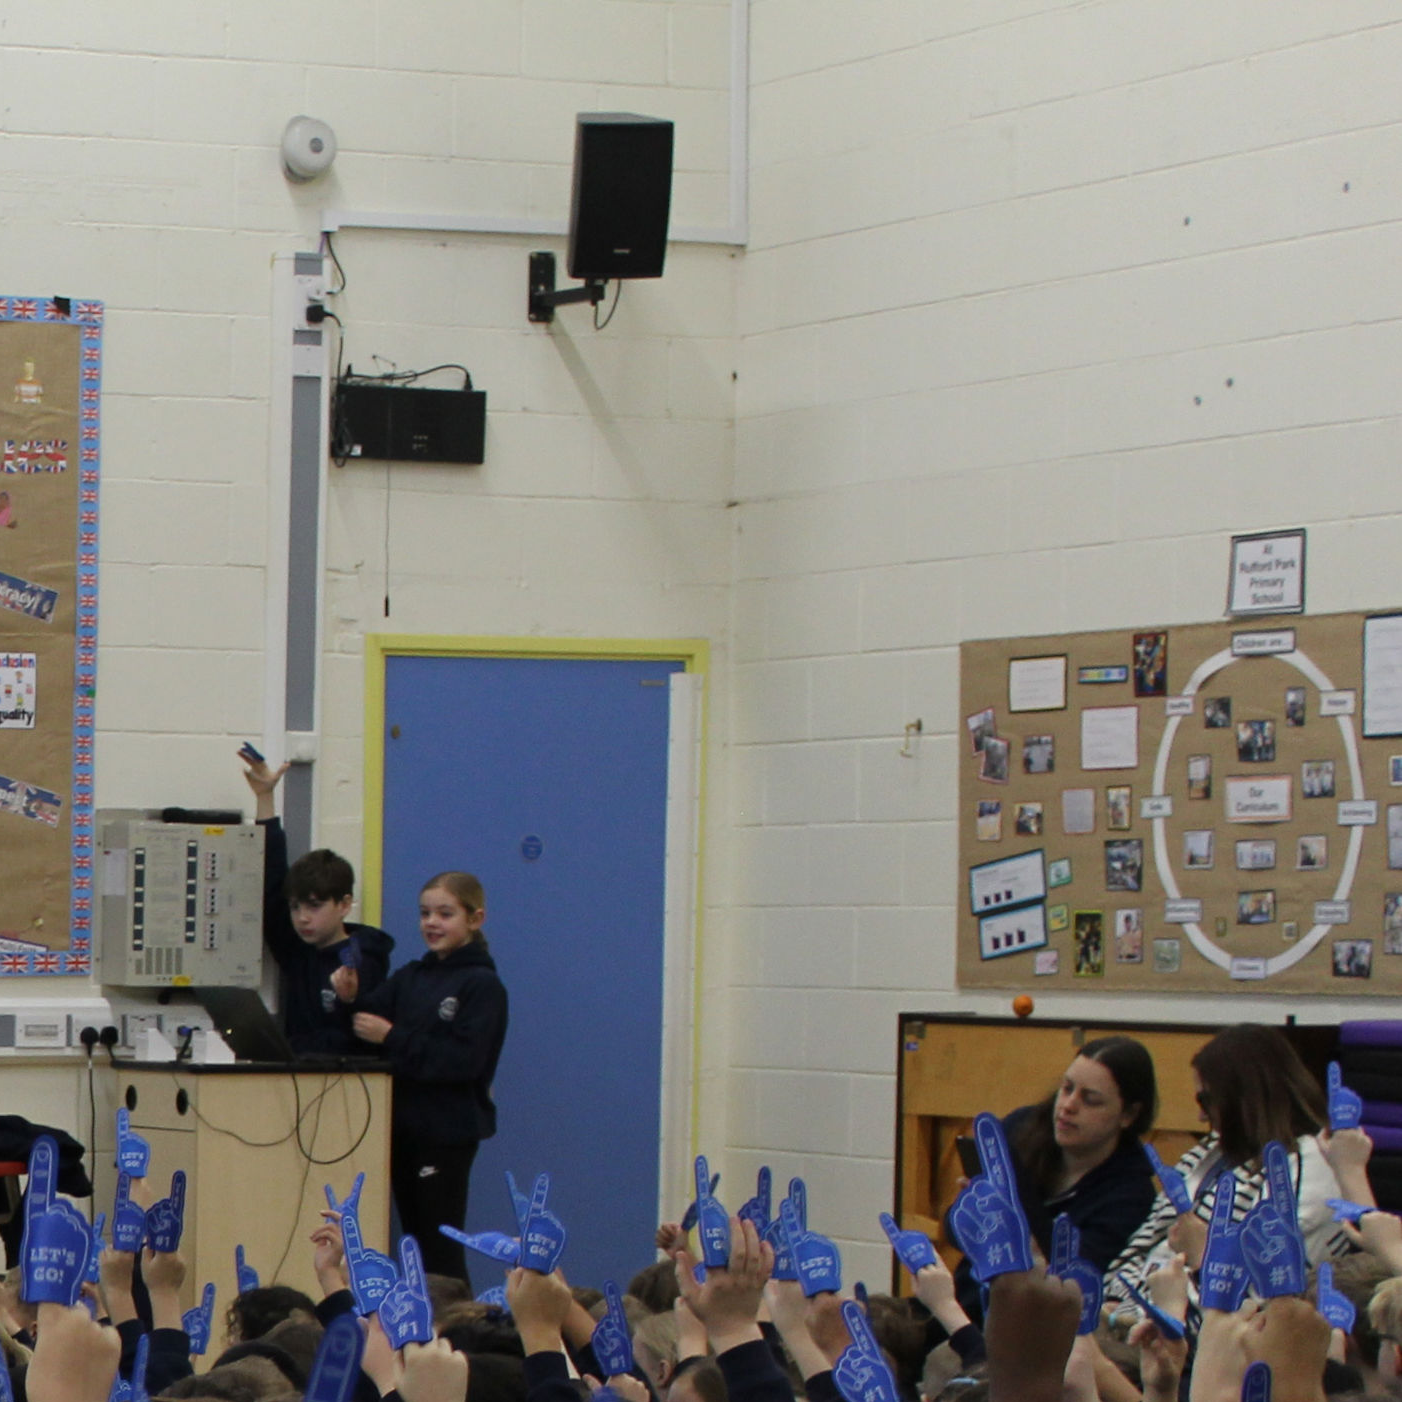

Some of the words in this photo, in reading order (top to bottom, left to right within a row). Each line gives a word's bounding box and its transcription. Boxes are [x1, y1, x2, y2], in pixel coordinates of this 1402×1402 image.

[121, 1152, 144, 1161] LET'S
[528, 1233, 557, 1248] LET'S
[31, 1248, 75, 1266] LET'S
[988, 1243, 1015, 1266] #1
[801, 1257, 832, 1270] LET'S
[1208, 1262, 1243, 1279] LET'S
[34, 1267, 64, 1283] GO!
[1269, 1266, 1294, 1285] #1
[359, 1277, 390, 1290] LET'S
[1210, 1280, 1232, 1293] GO!
[397, 1321, 419, 1337] #1
